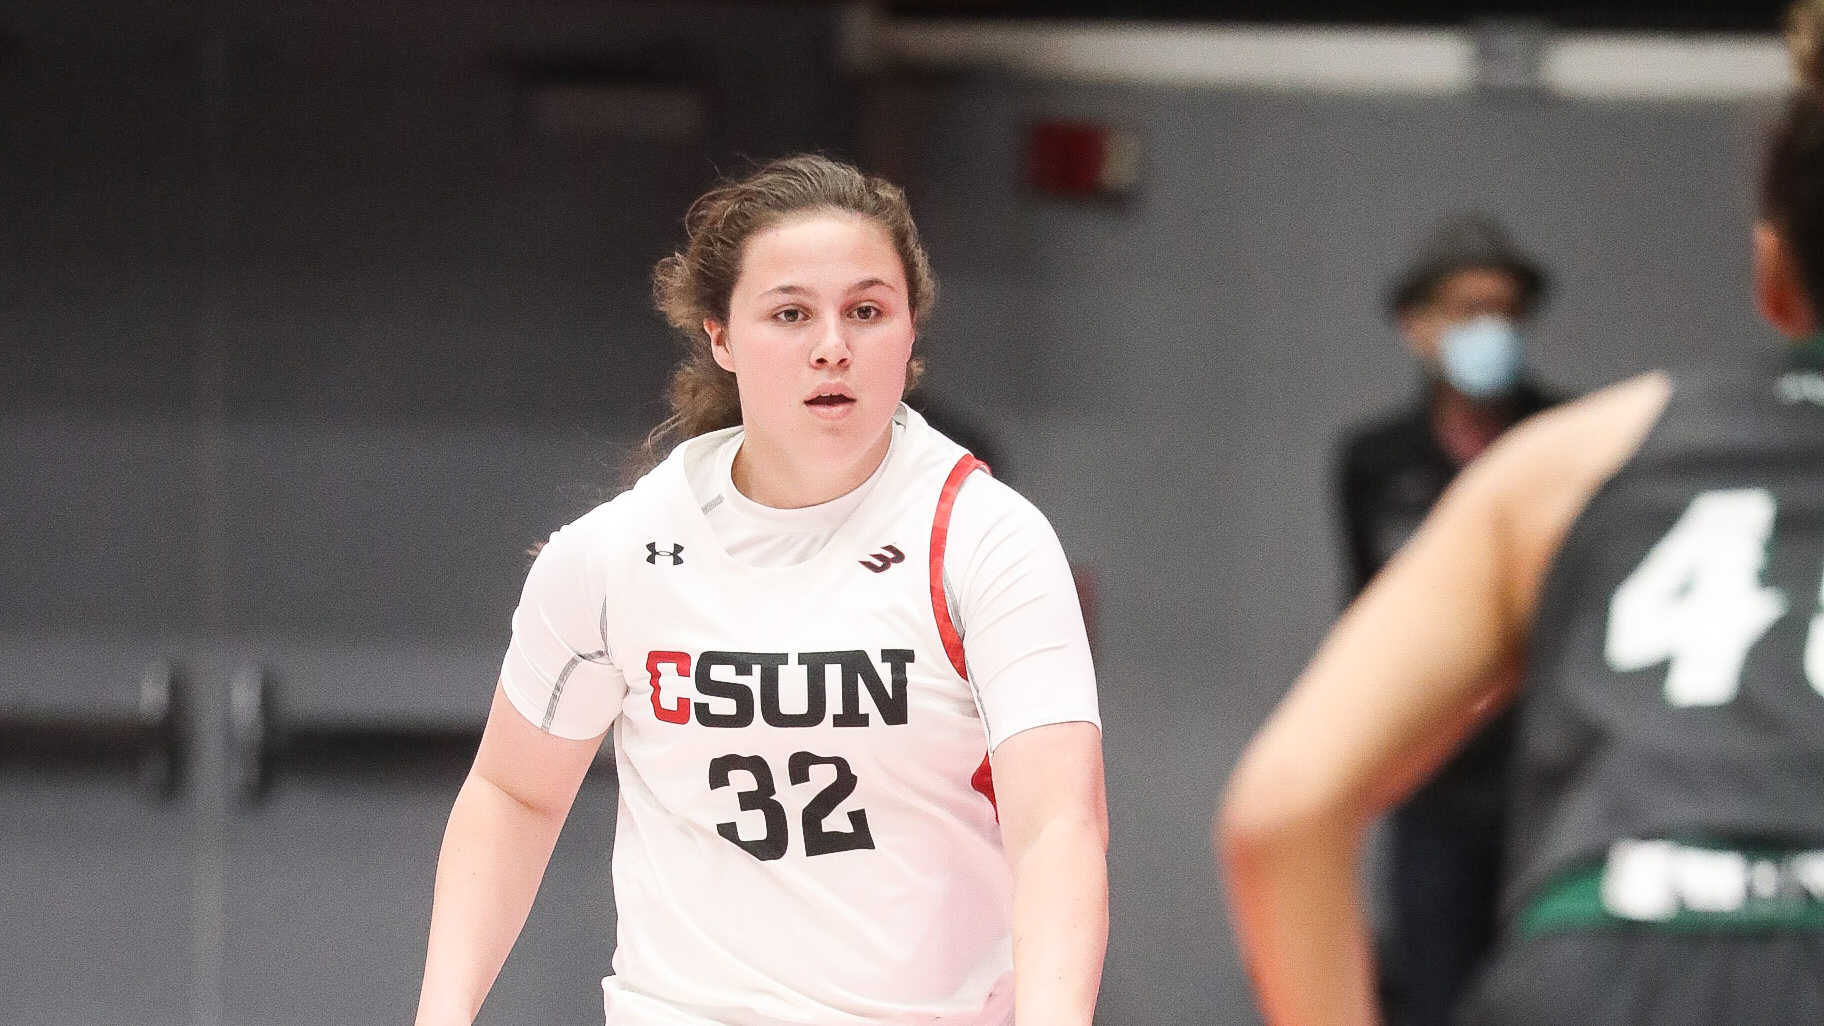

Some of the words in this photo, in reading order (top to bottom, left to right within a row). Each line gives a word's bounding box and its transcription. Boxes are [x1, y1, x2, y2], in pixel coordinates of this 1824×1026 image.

[1604, 487, 1824, 706] 4
[646, 649, 915, 728] CSUN
[709, 751, 876, 861] 32
